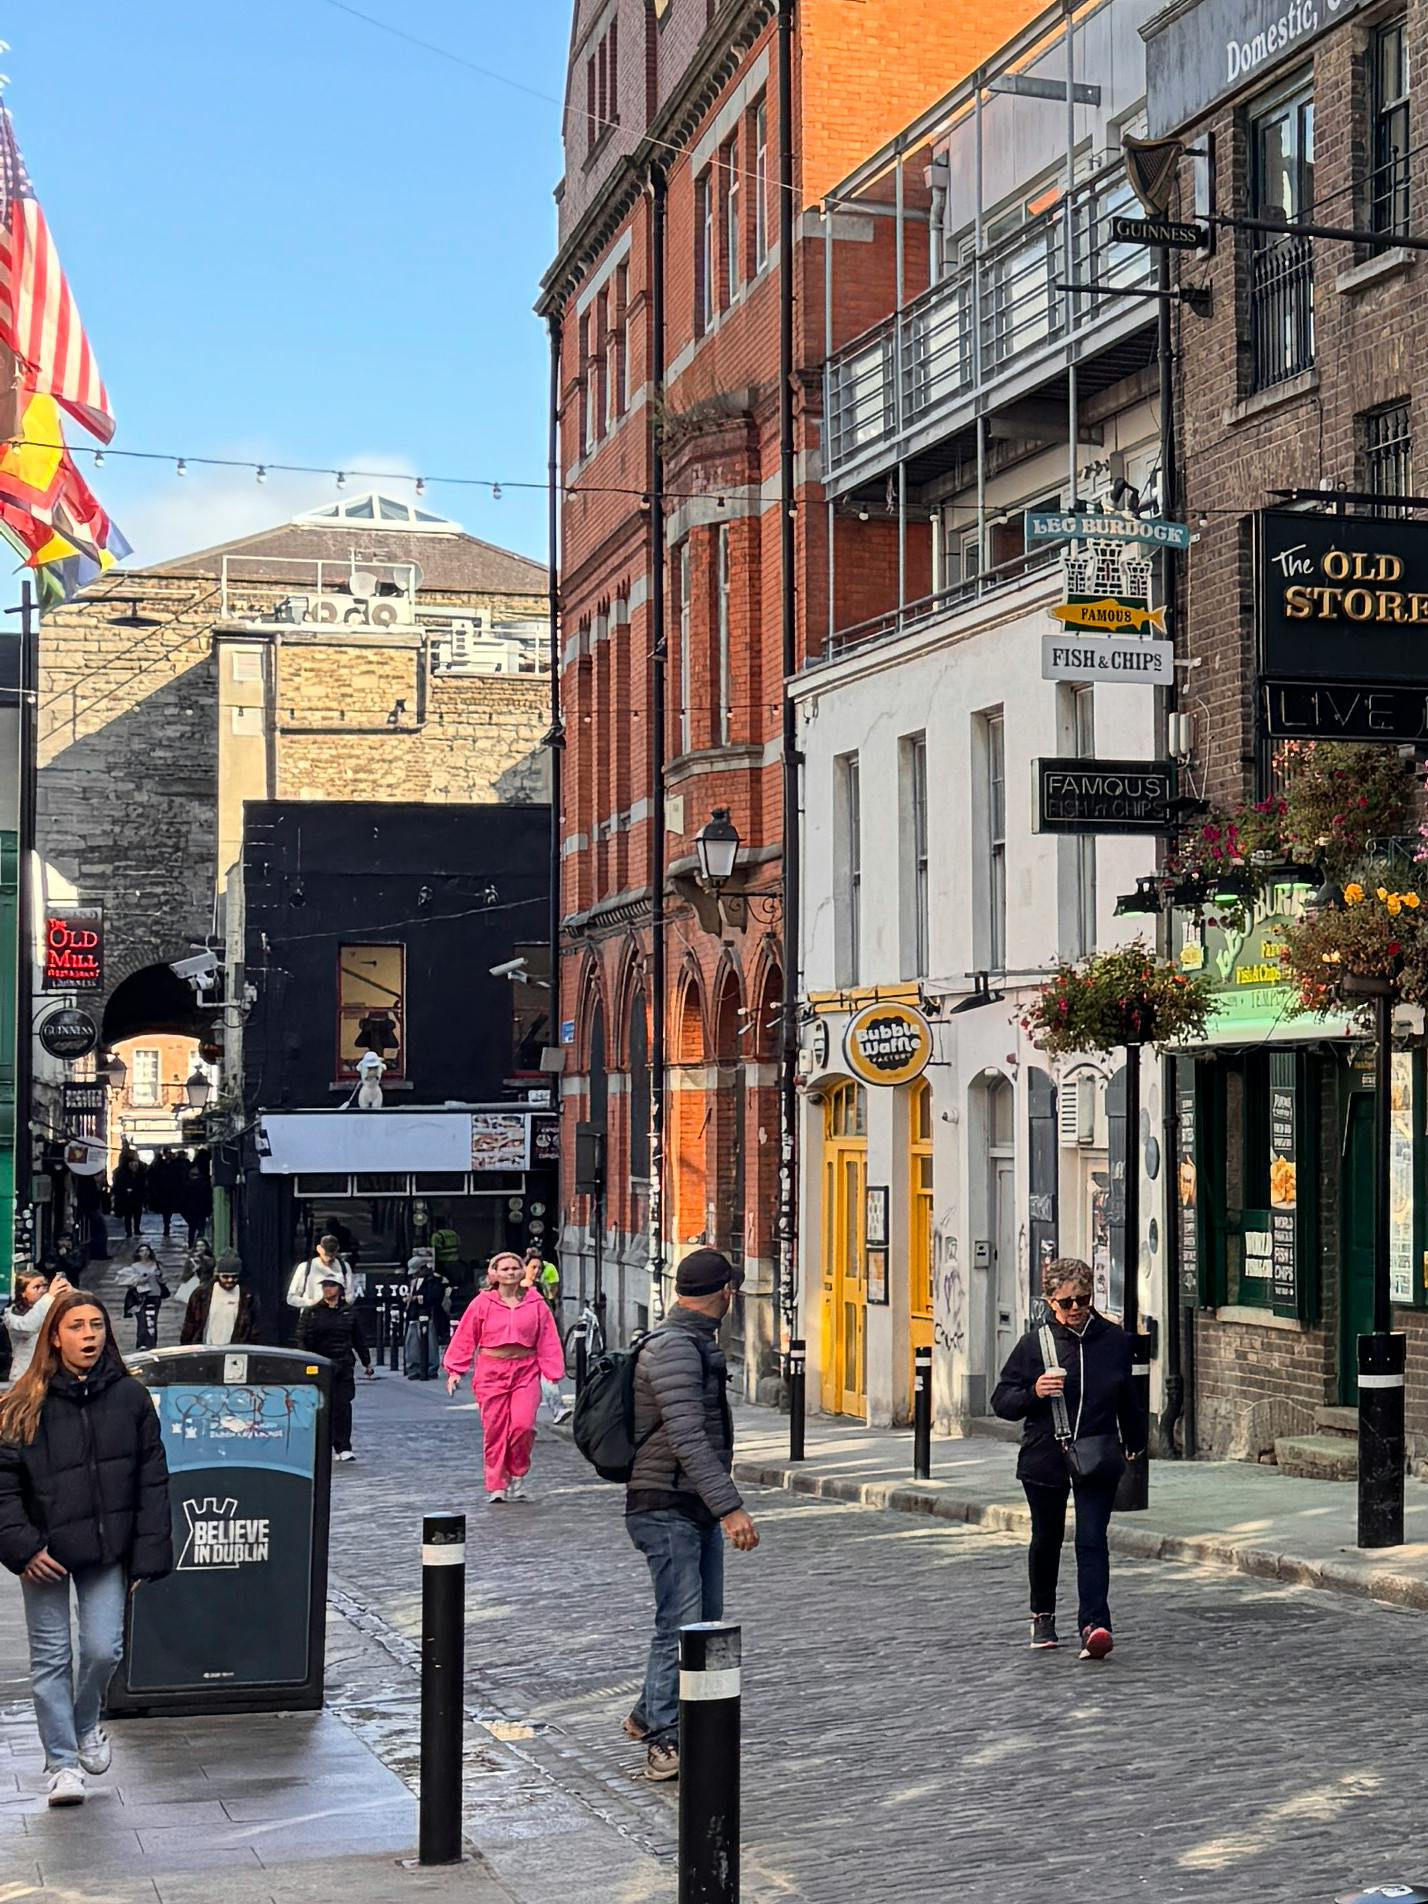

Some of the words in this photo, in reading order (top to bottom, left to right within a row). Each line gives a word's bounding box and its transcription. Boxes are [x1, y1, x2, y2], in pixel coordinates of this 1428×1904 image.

[1082, 518, 1184, 544] BURDOCK
[1272, 544, 1314, 578] The
[1322, 551, 1404, 583] OLD
[1081, 608, 1132, 623] FAMOUS
[1052, 648, 1096, 669] FISH
[1280, 690, 1395, 730] LIVE
[1049, 776, 1161, 797] FAMOUS
[1049, 799, 1088, 818] FISH
[856, 1022, 920, 1043] Bubble
[860, 1037, 921, 1057] Waffle
[194, 1519, 270, 1545] BELIEVE
[194, 1544, 211, 1564] IN
[213, 1542, 269, 1563] DUBLIN
